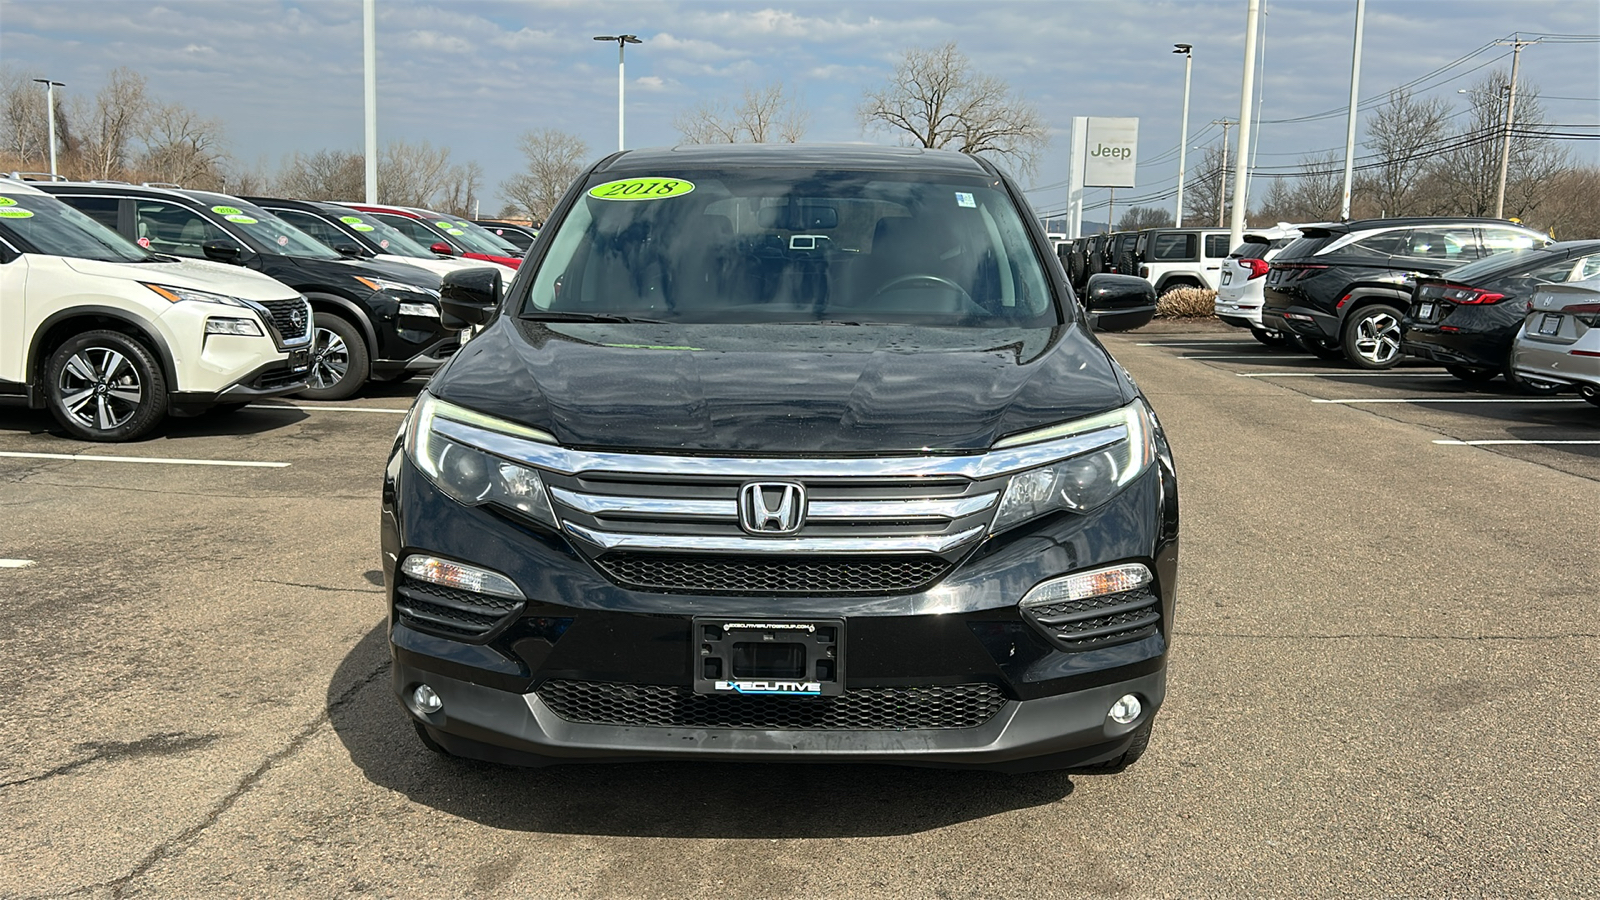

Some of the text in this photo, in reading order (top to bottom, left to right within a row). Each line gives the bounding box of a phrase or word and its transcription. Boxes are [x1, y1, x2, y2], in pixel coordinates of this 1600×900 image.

[1090, 143, 1132, 161] Jeep
[602, 181, 679, 196] 2018
[714, 680, 821, 693] EXECUTIVE
